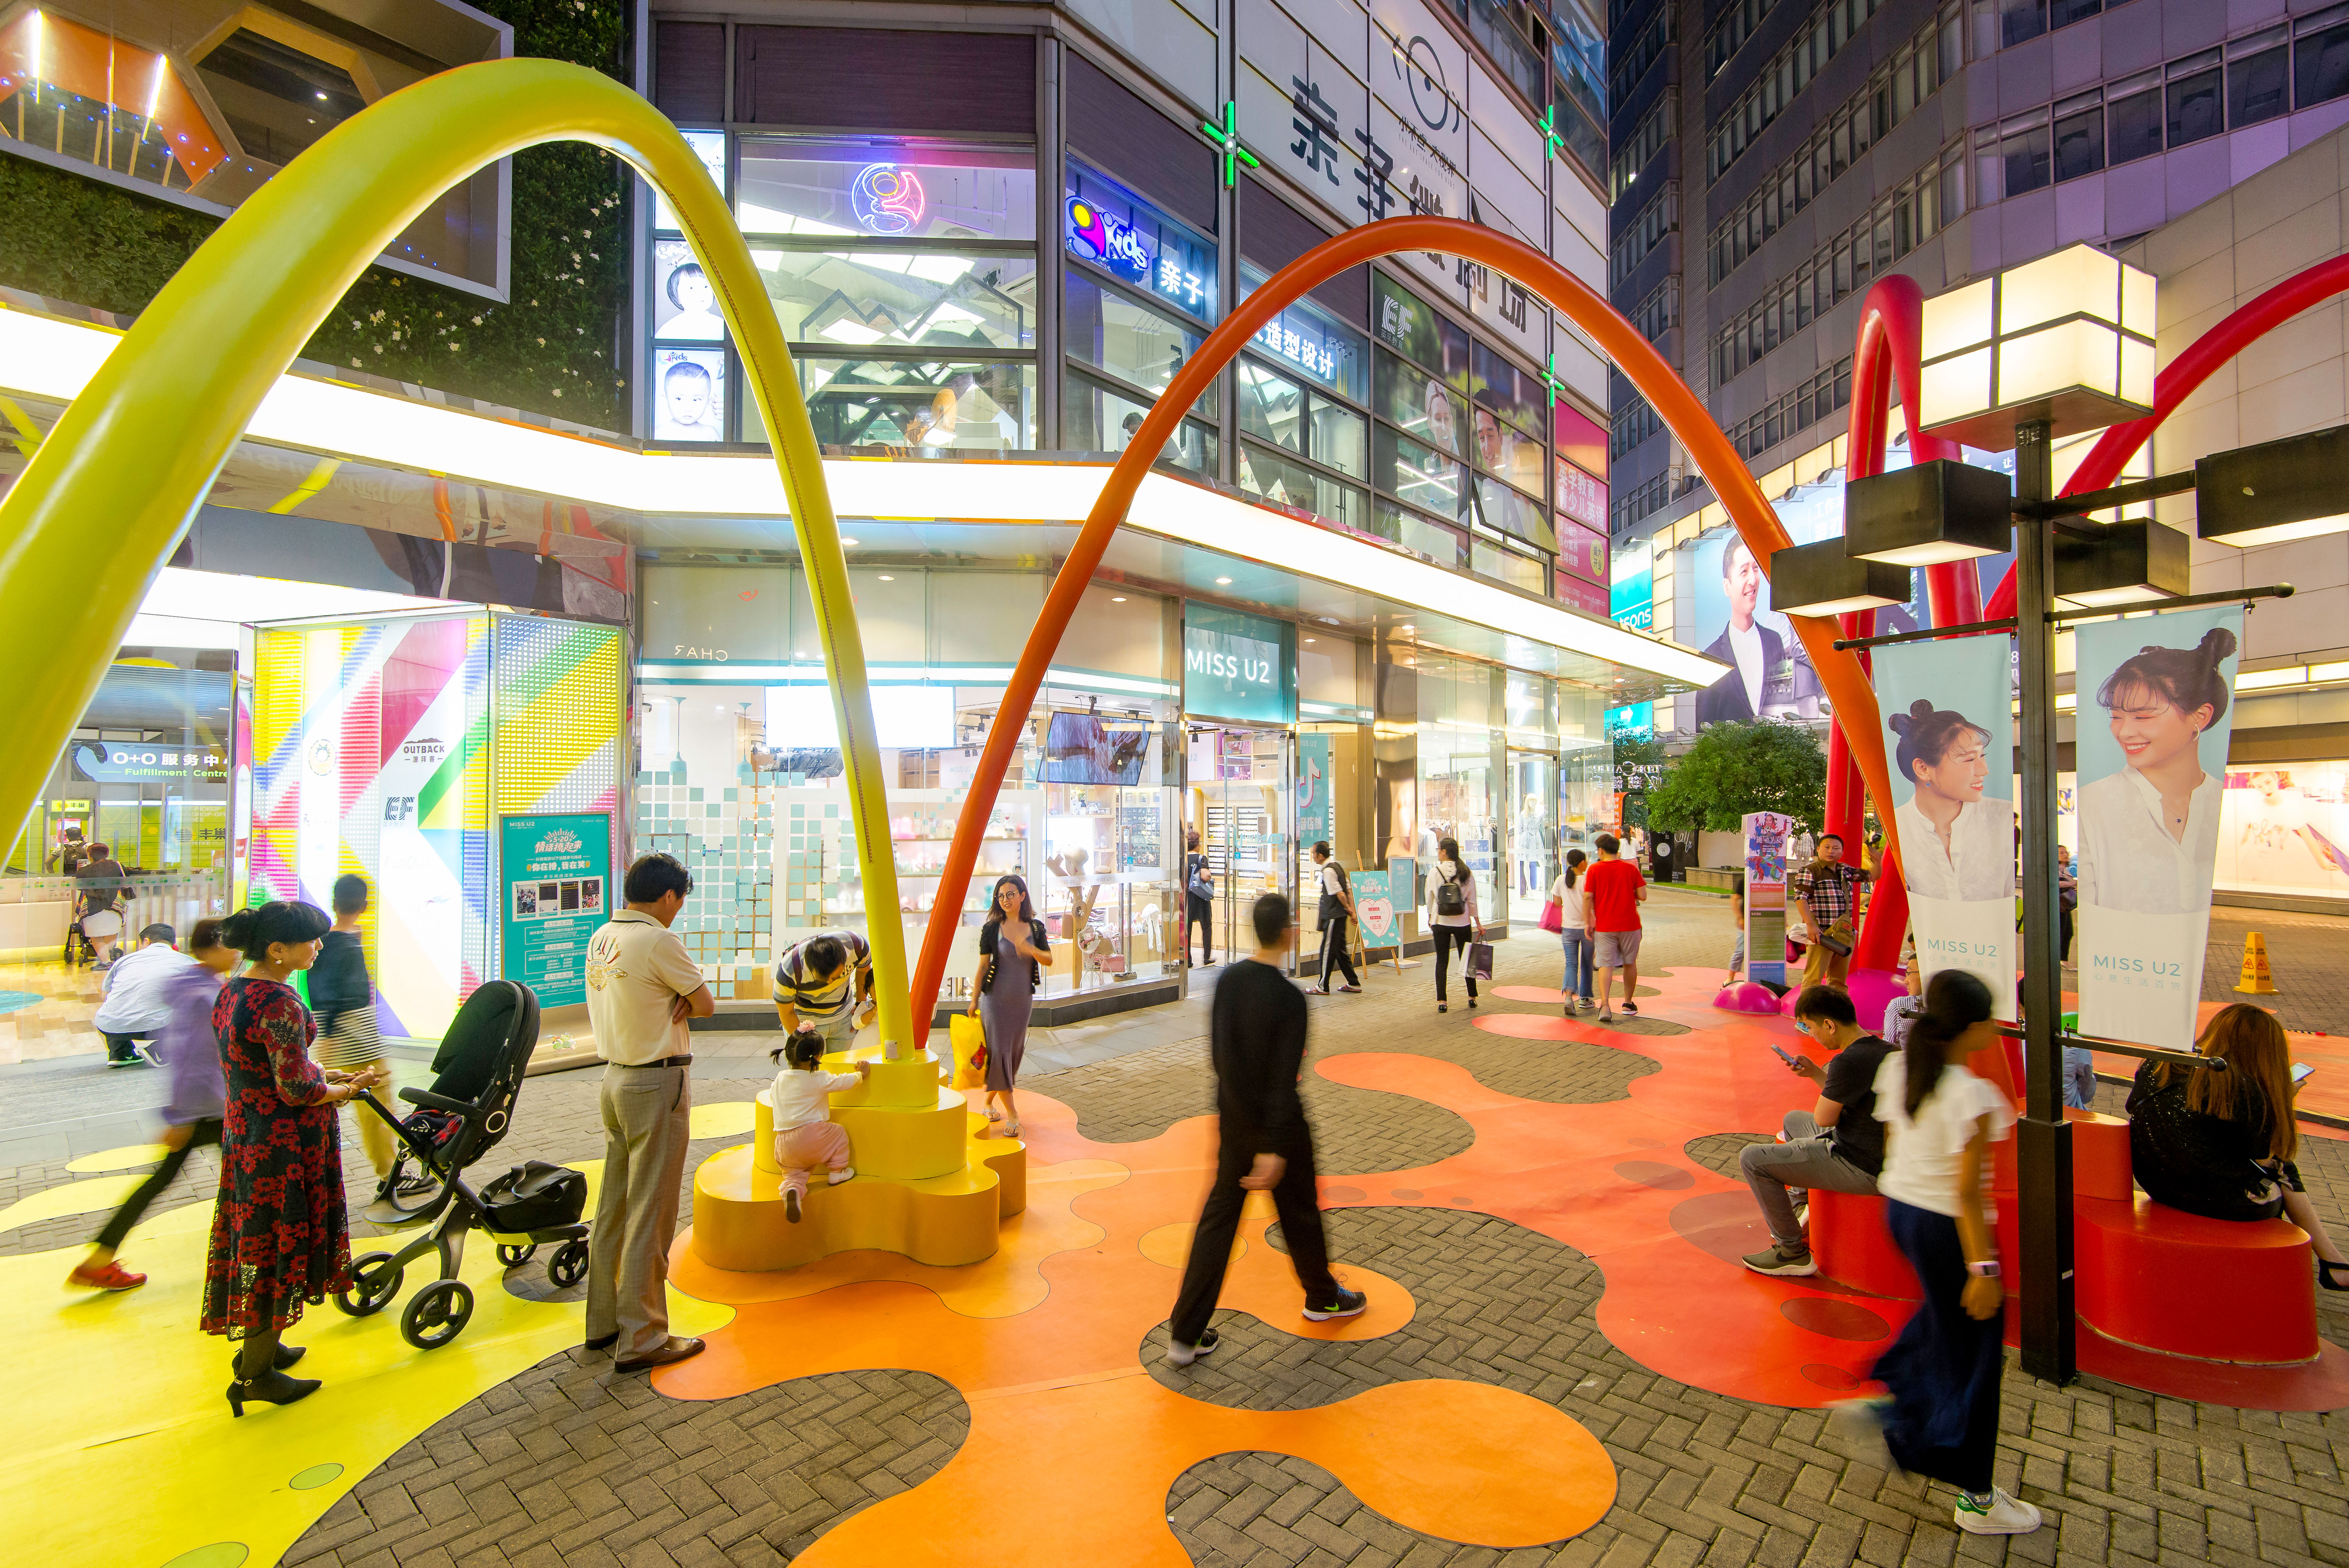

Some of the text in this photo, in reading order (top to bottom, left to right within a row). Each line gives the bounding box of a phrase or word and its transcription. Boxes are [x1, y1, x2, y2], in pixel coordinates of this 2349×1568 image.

[1420, 153, 1433, 169] SPACE
[1445, 177, 1455, 190] KIDS
[1160, 258, 1203, 304] 亲子
[1381, 328, 1403, 351] 英孚教育
[1558, 462, 1595, 501] 英孚教育
[1558, 486, 1605, 528] 青少儿英语
[1593, 558, 1602, 570] 开业
[1187, 649, 1237, 678] MISS
[1244, 658, 1270, 683] U2
[403, 745, 445, 754] OUTBACK
[125, 768, 187, 777] Fulfillment
[1928, 938, 1998, 958] MISS U2
[1928, 955, 1998, 970] 心意生活百货
[2094, 954, 2182, 977] MISS U2
[2094, 972, 2181, 991] 心意生活百货
